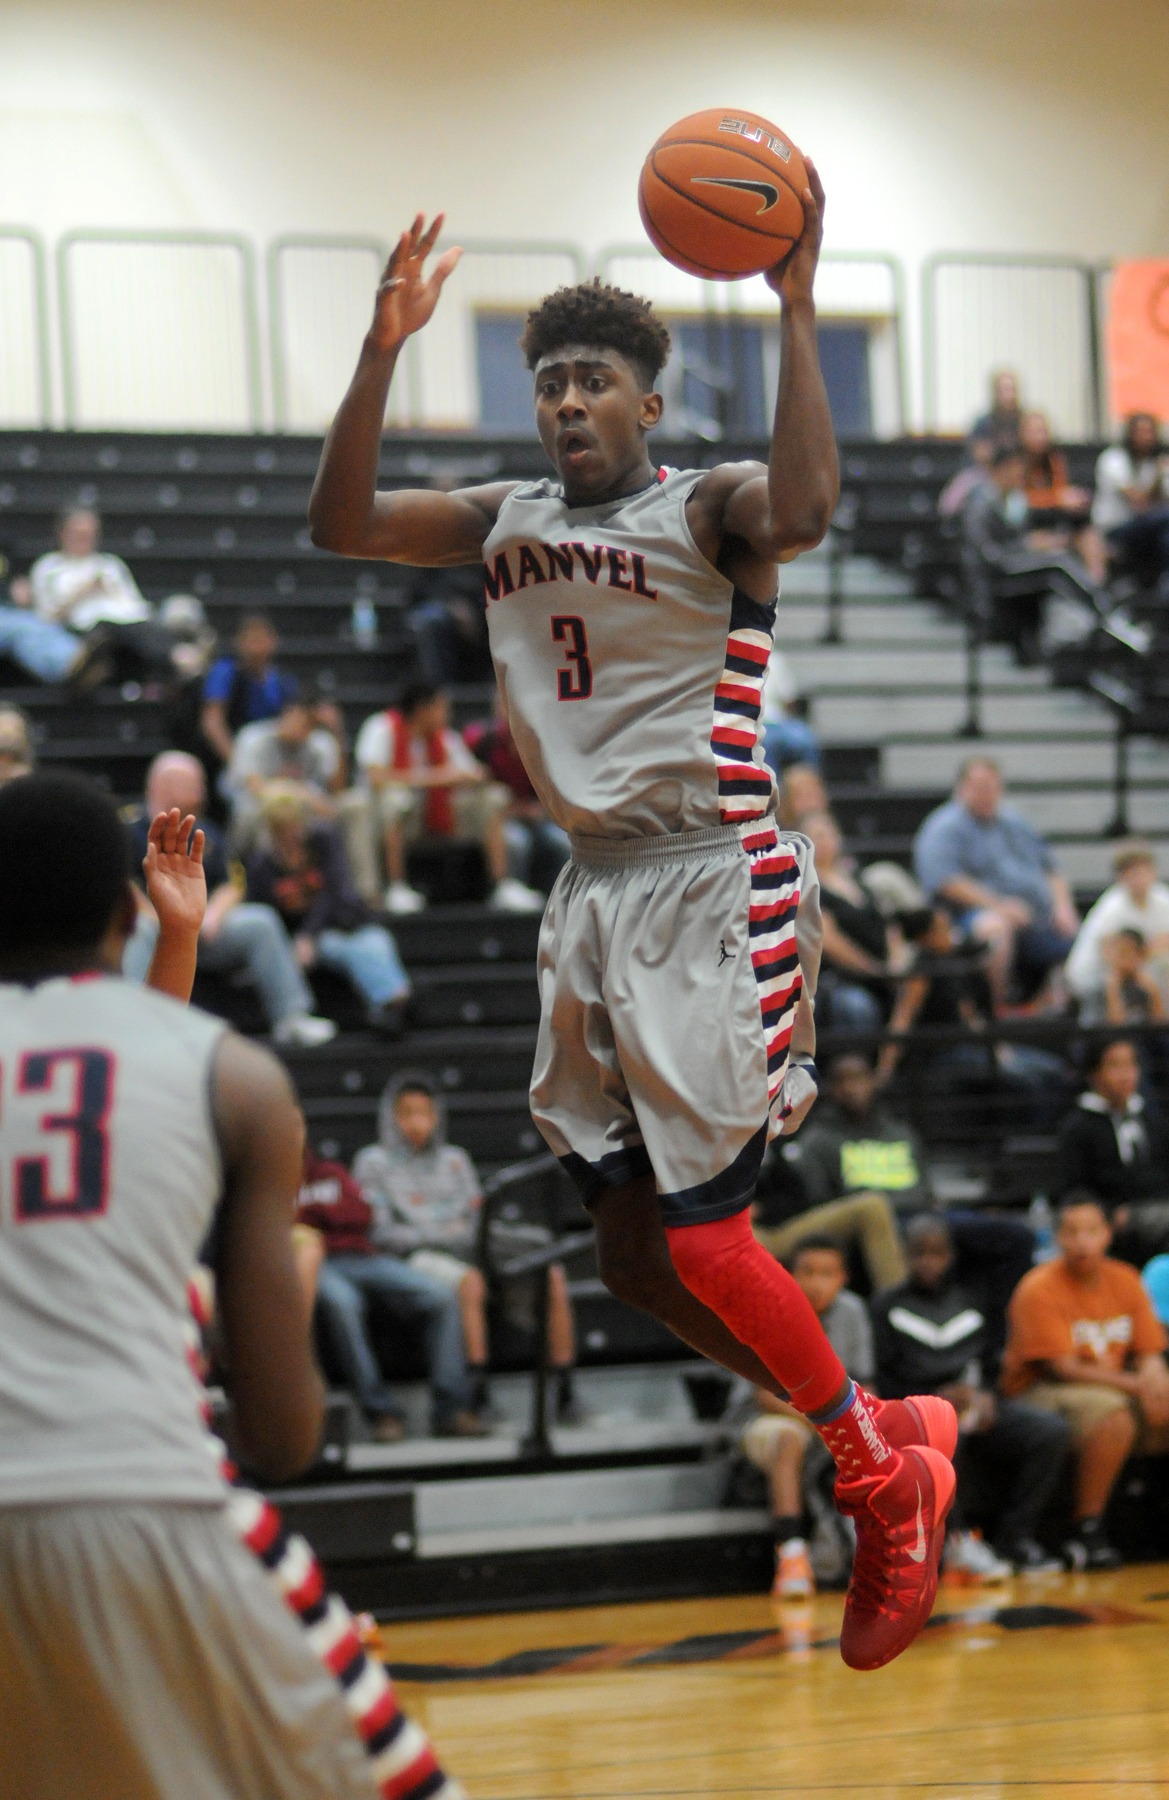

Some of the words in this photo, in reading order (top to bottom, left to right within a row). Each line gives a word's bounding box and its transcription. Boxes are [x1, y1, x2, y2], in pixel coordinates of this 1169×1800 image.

[718, 117, 791, 163] ELITE
[484, 541, 658, 608] MANVEL
[550, 615, 593, 701] 3
[0, 1046, 116, 1223] 3
